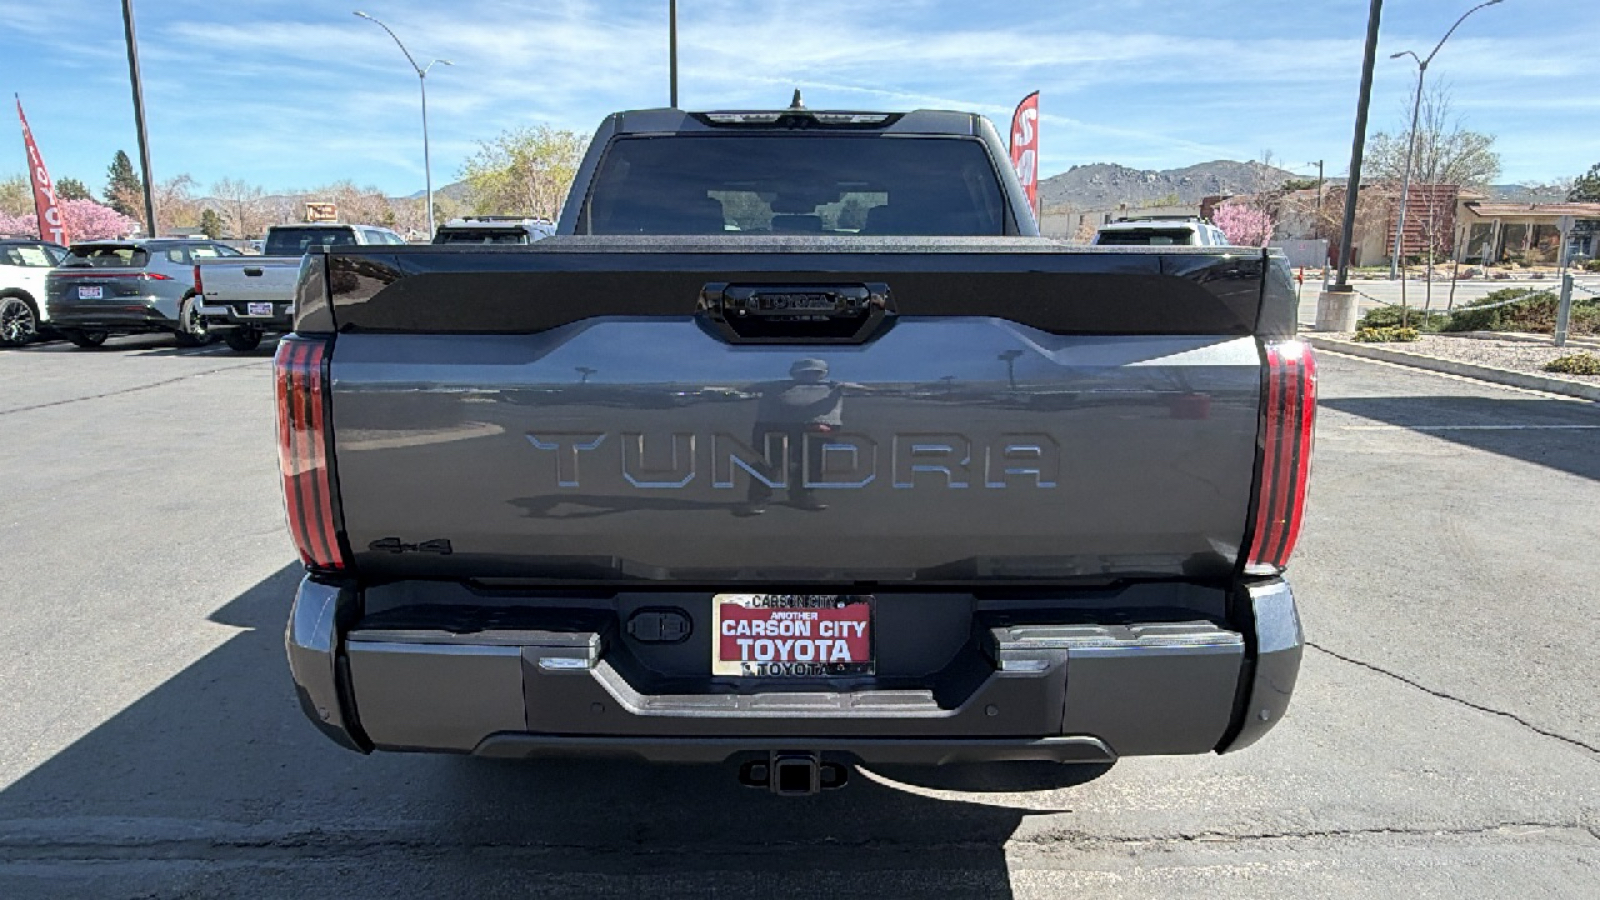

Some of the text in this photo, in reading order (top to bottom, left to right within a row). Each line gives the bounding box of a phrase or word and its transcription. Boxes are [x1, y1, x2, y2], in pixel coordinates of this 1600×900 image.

[762, 294, 835, 310] TOYOTA
[525, 430, 1061, 488] TUNDRA
[752, 594, 837, 608] CARSON CITY
[770, 611, 818, 621] ANOTHER
[721, 619, 867, 638] CARSON CITY
[736, 638, 852, 661] TOYOTA
[757, 662, 829, 676] TOYOTA
